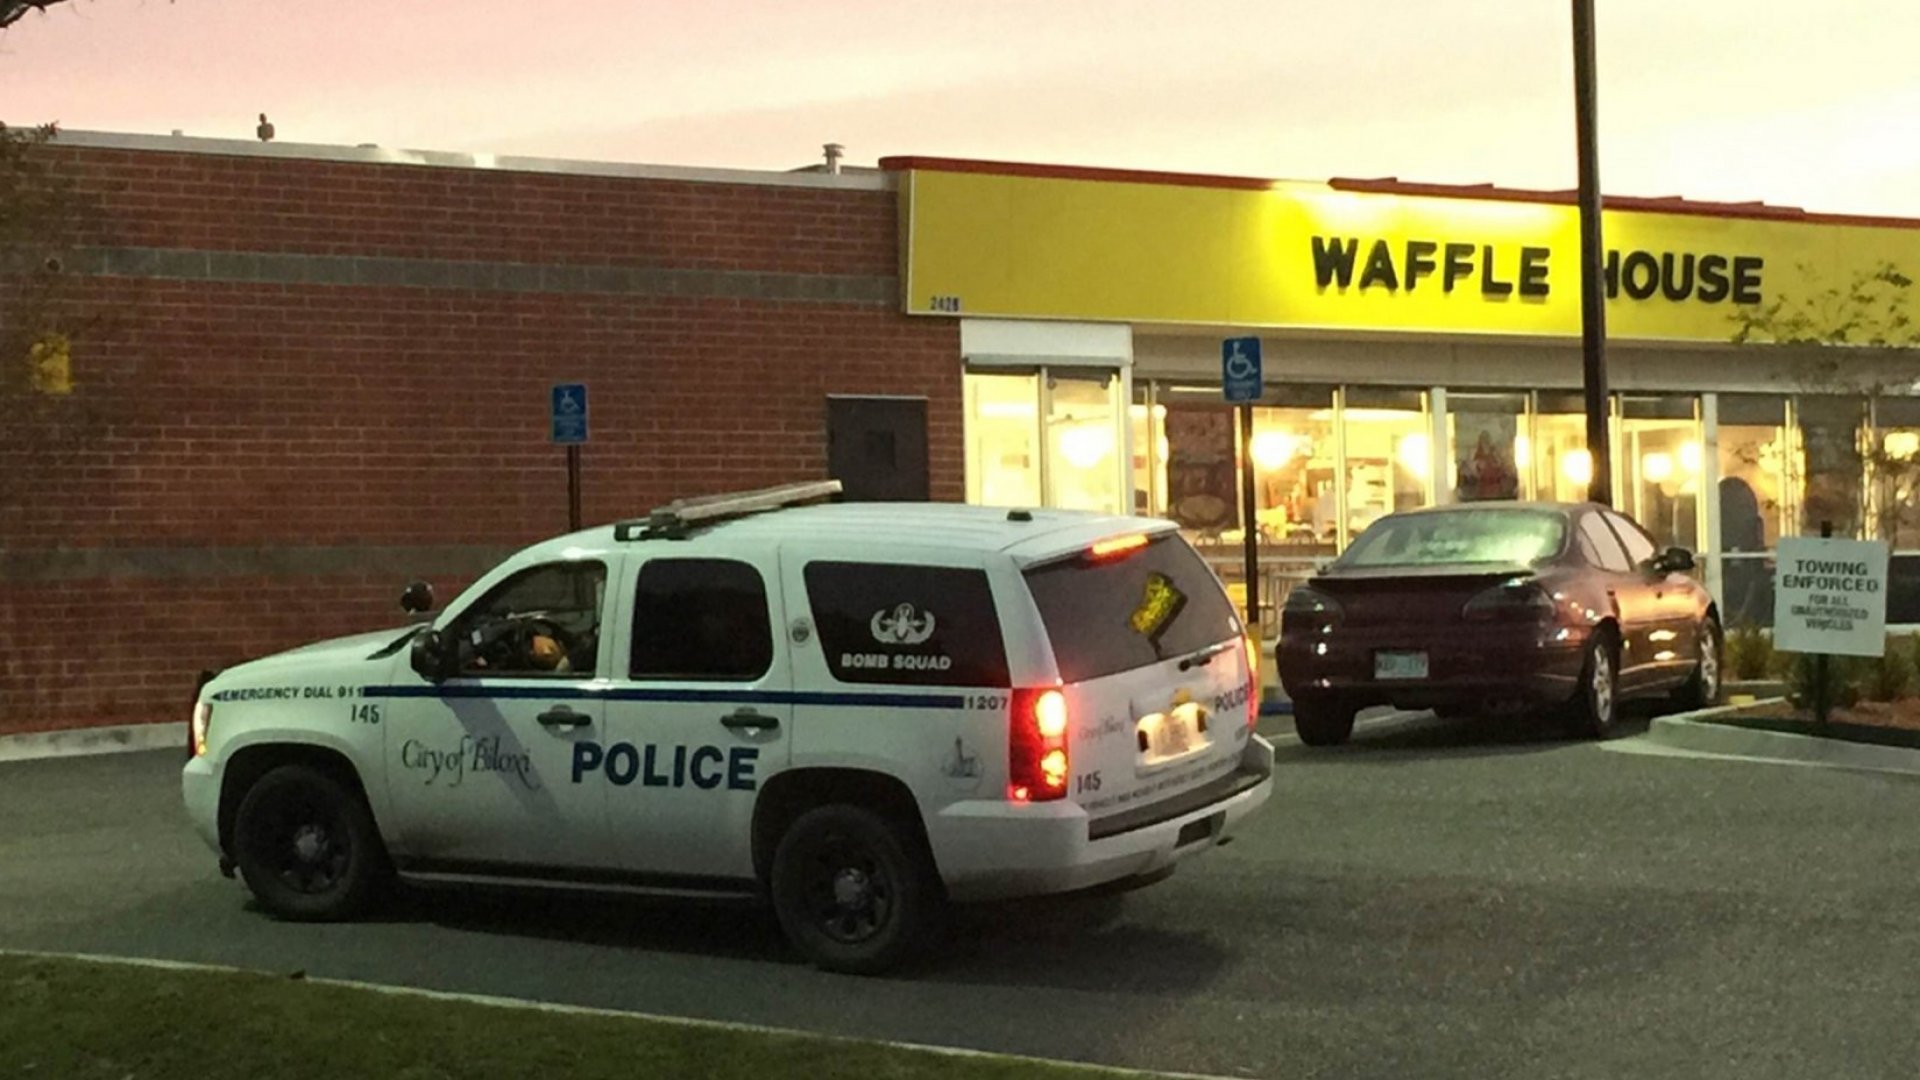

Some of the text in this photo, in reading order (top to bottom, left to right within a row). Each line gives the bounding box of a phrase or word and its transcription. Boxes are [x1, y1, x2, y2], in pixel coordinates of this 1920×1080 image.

[1311, 235, 1551, 298] WAFFLE
[1796, 560, 1868, 576] TOWING
[1782, 574, 1879, 593] ENFORCED
[841, 653, 951, 670] BOMB SQUAD
[219, 685, 364, 701] EMERGENCY DIAL 911
[967, 696, 1008, 711] 1207
[351, 704, 379, 724] 145
[402, 739, 444, 785] City
[571, 741, 760, 790] POLICE
